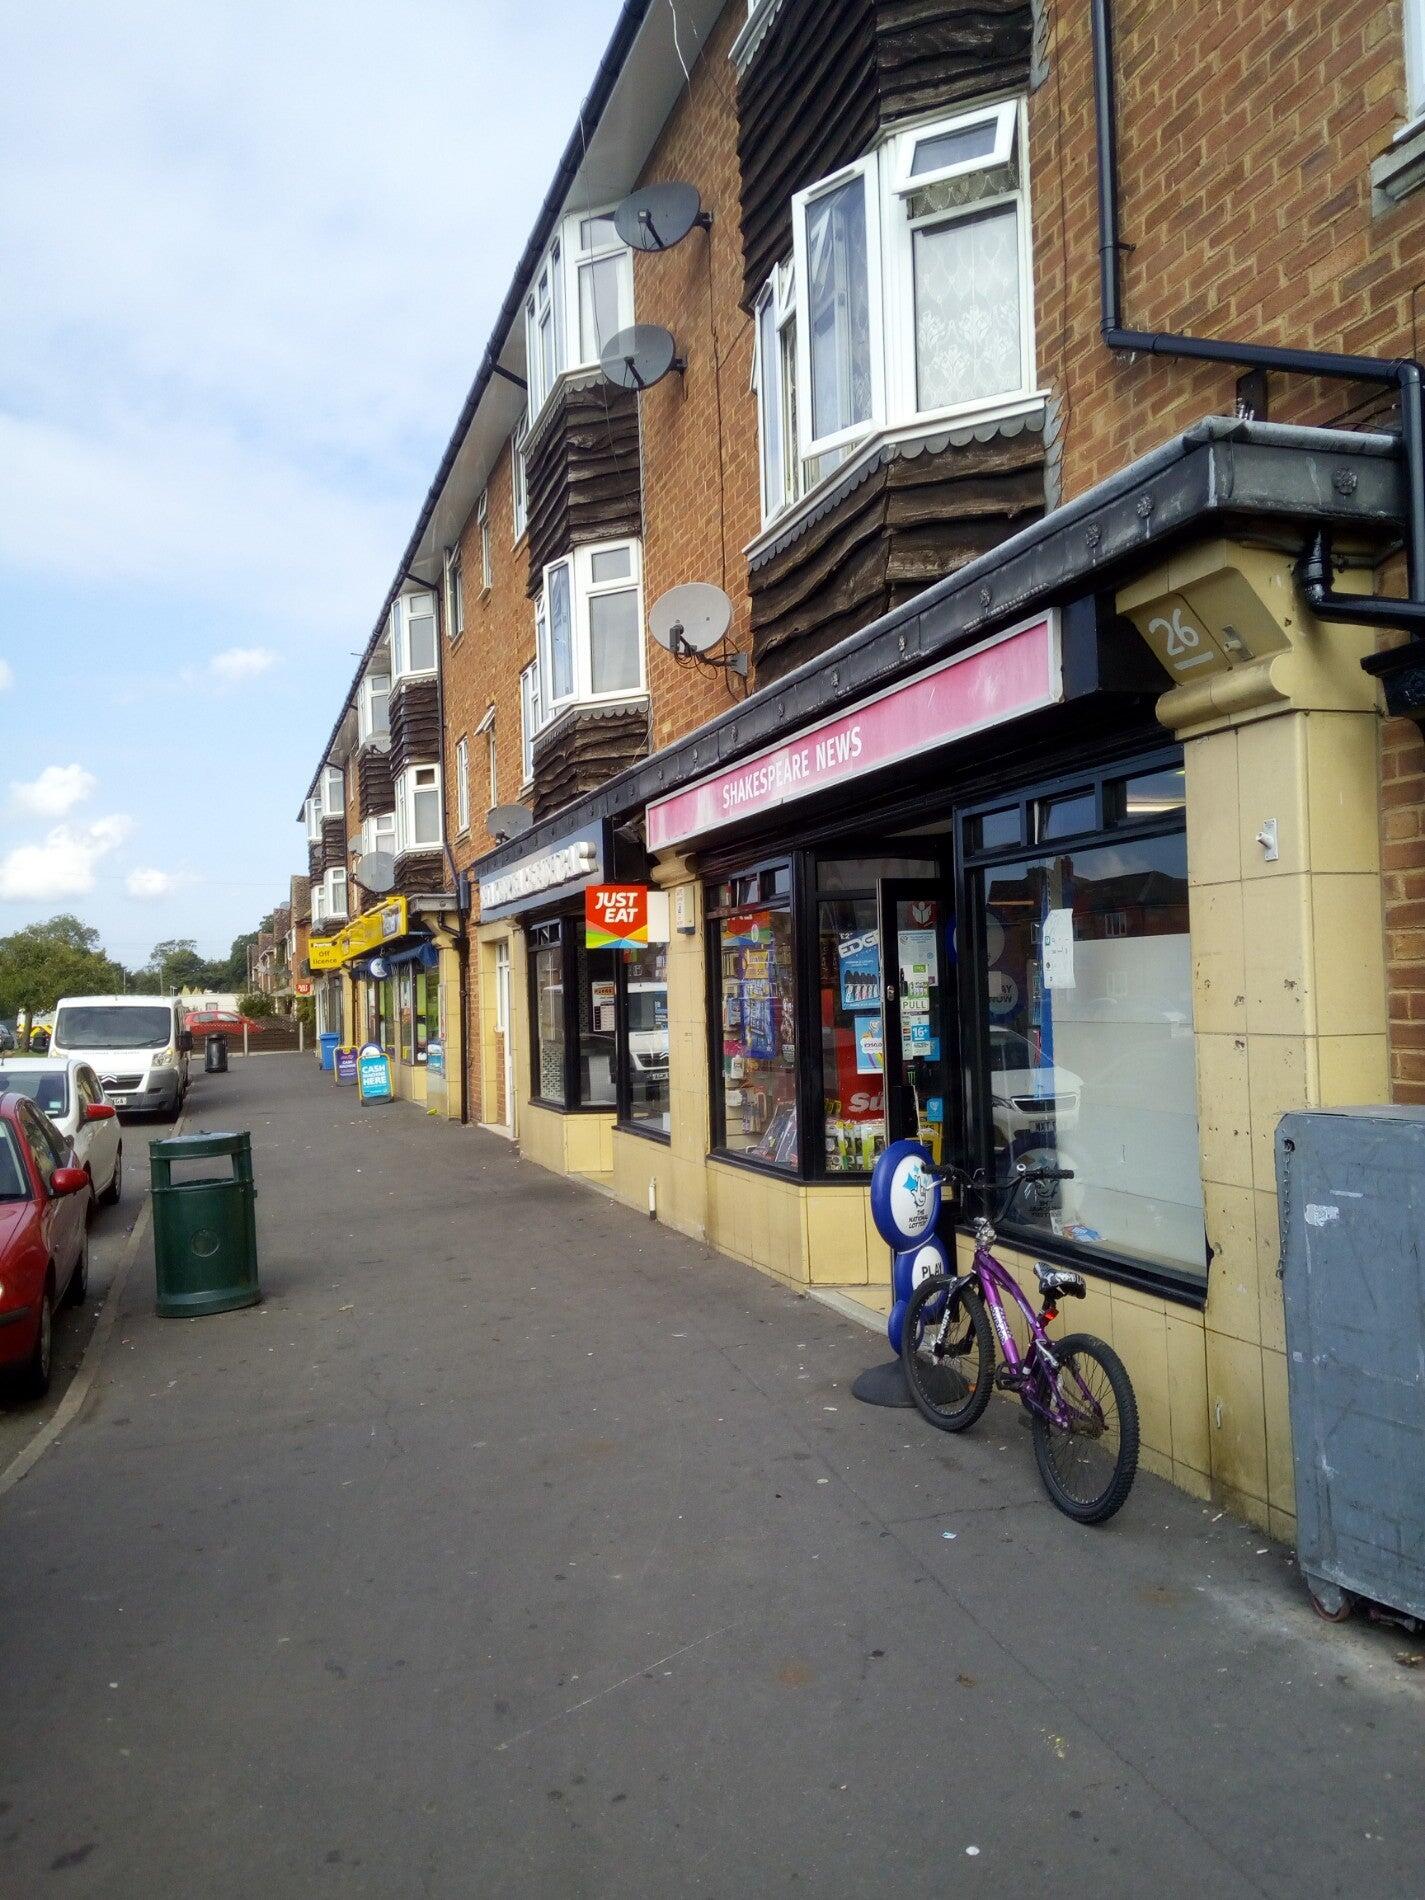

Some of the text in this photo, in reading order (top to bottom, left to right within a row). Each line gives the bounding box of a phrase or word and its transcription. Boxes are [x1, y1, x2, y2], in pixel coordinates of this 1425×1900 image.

[1148, 608, 1200, 656] 26
[722, 725, 863, 809] SHAKESPEARE NEWS
[594, 891, 639, 910] JUST
[604, 907, 639, 923] EAT
[838, 928, 880, 959] EDG
[902, 1000, 927, 1009] PULL
[912, 1026, 929, 1037] 16+
[361, 1065, 386, 1074] CASH
[362, 1076, 387, 1086] HERE
[848, 1091, 885, 1113] Su
[921, 1261, 942, 1279] PLAY
